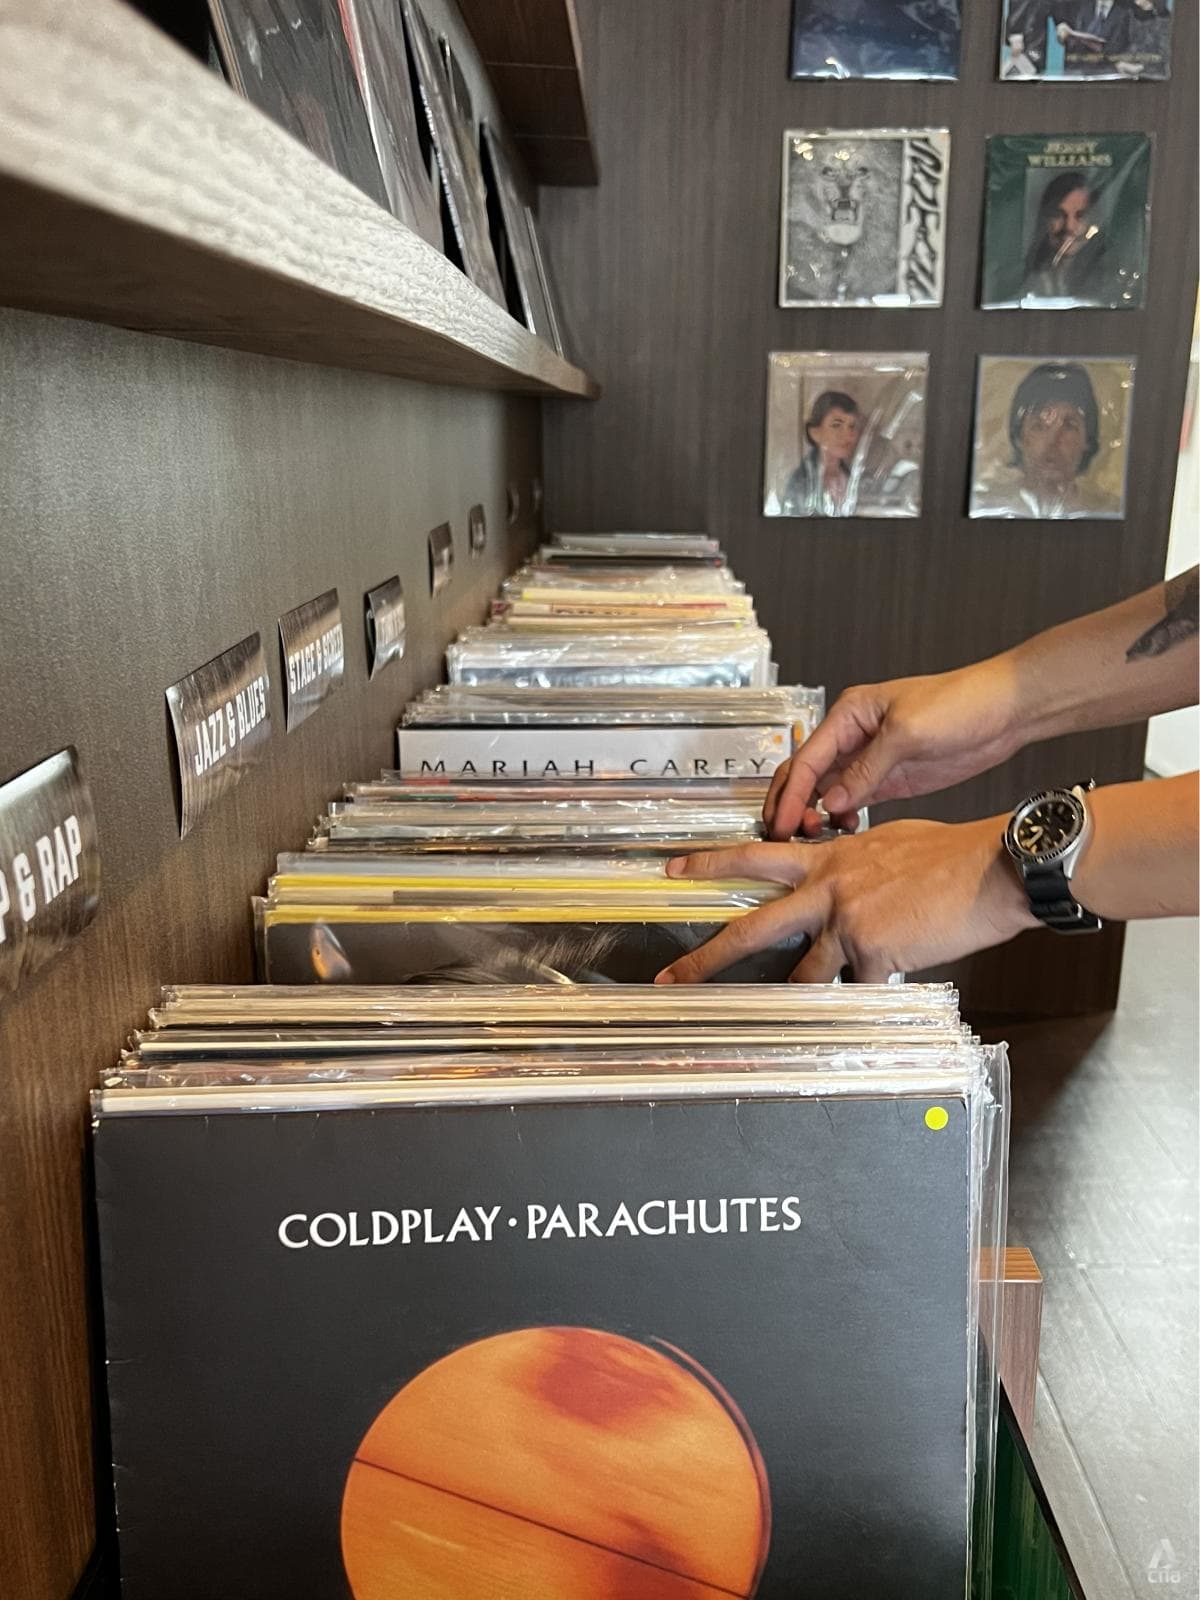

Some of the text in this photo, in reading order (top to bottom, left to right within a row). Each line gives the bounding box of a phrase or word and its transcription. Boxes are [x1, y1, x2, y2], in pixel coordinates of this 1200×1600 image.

[288, 642, 316, 695] STAGE
[316, 638, 322, 675] &
[195, 676, 266, 777] JAZZ & BLUES
[420, 758, 768, 777] MARIAH CAREY
[13, 852, 36, 922] &
[35, 815, 82, 904] RAP
[278, 1196, 801, 1249] COLDPLAY PARACHUTES
